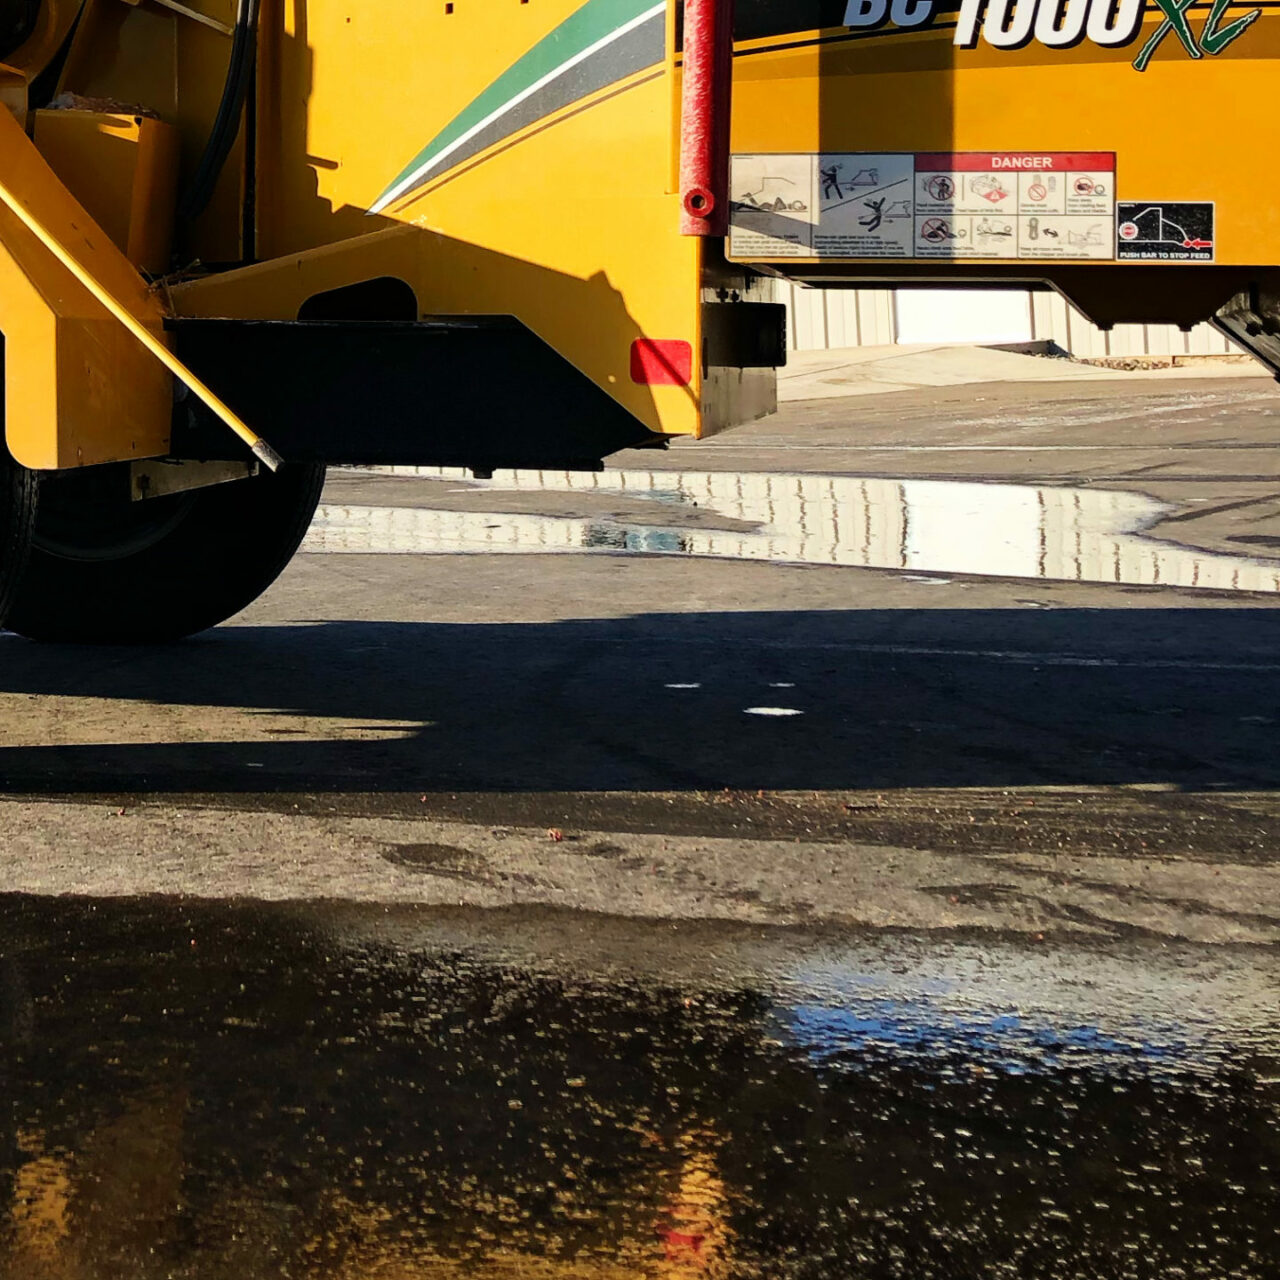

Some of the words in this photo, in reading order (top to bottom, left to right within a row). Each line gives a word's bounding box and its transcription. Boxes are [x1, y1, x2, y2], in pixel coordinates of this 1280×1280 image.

[991, 156, 1053, 169] DANGER
[1120, 251, 1140, 259] PUSH
[1141, 251, 1157, 259] BAR
[1158, 251, 1169, 259] TO
[1169, 251, 1190, 259] STOP
[1190, 251, 1210, 259] FEED
